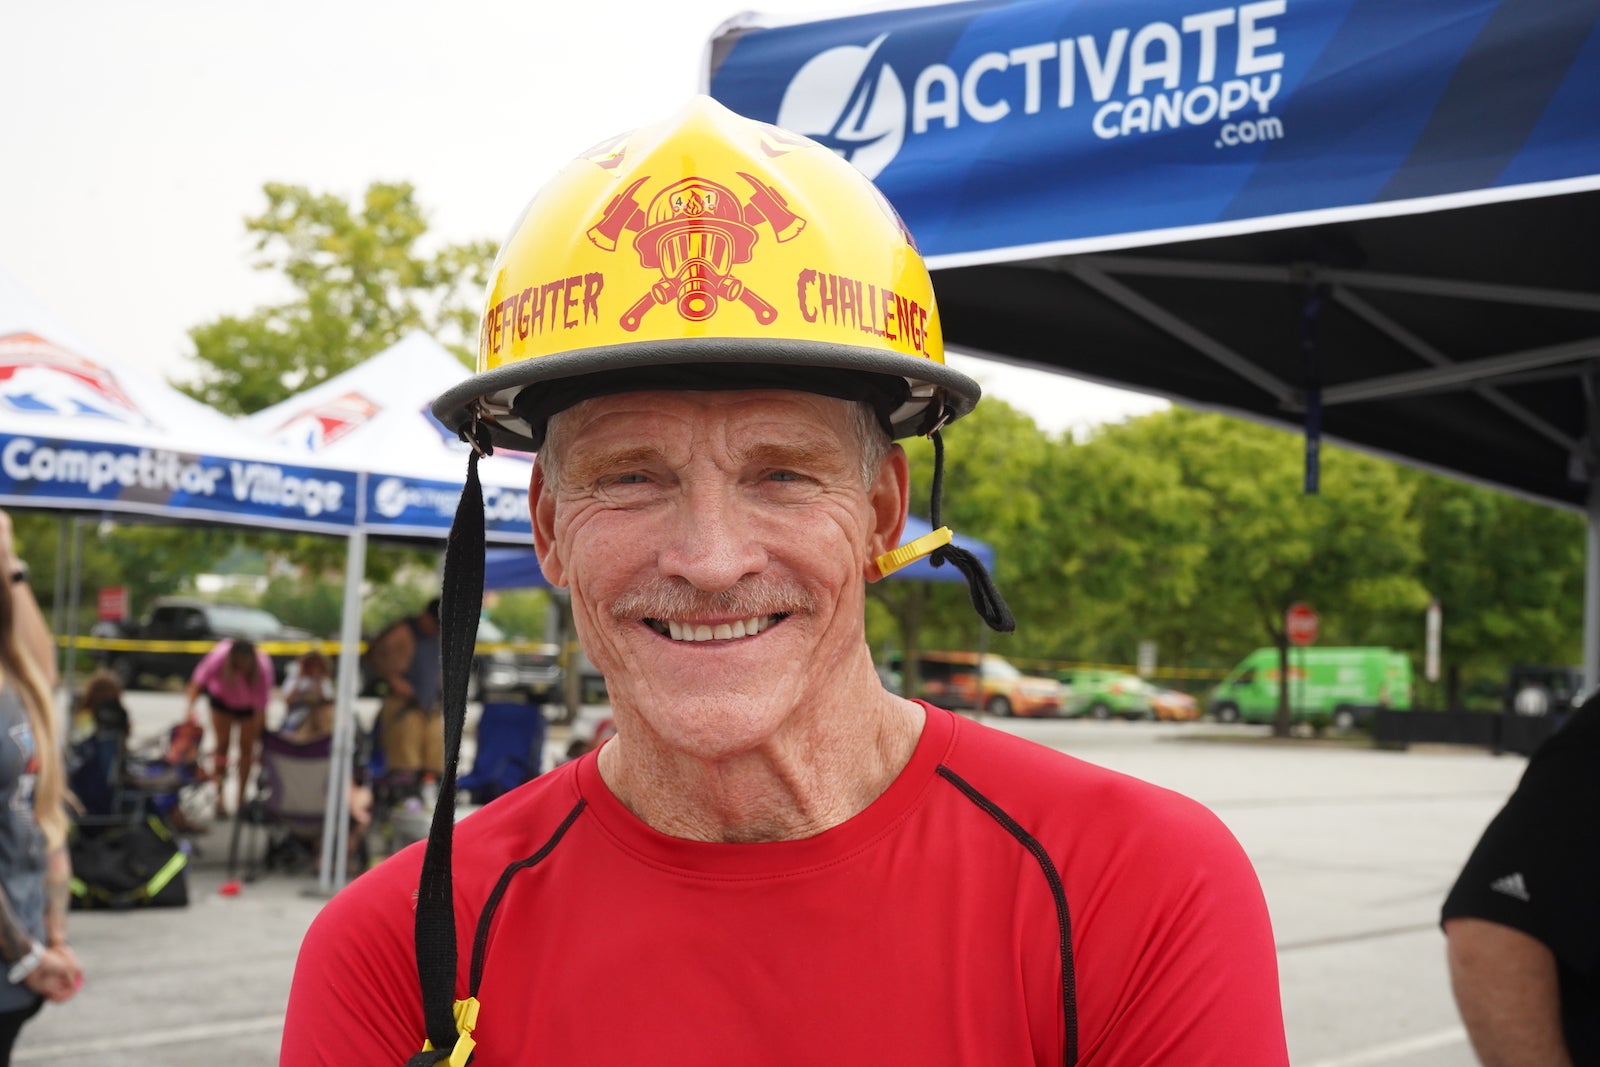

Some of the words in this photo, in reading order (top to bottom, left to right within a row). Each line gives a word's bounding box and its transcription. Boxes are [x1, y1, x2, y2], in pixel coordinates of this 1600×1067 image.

[912, 0, 1287, 134] ACTIVATE
[1092, 72, 1282, 139] CANOPY
[1214, 117, 1284, 149] .com
[675, 197, 683, 206] 4
[705, 194, 711, 204] 1
[797, 268, 930, 359] CHALLENGE
[2, 437, 225, 495] Competitor
[229, 461, 344, 517] Village
